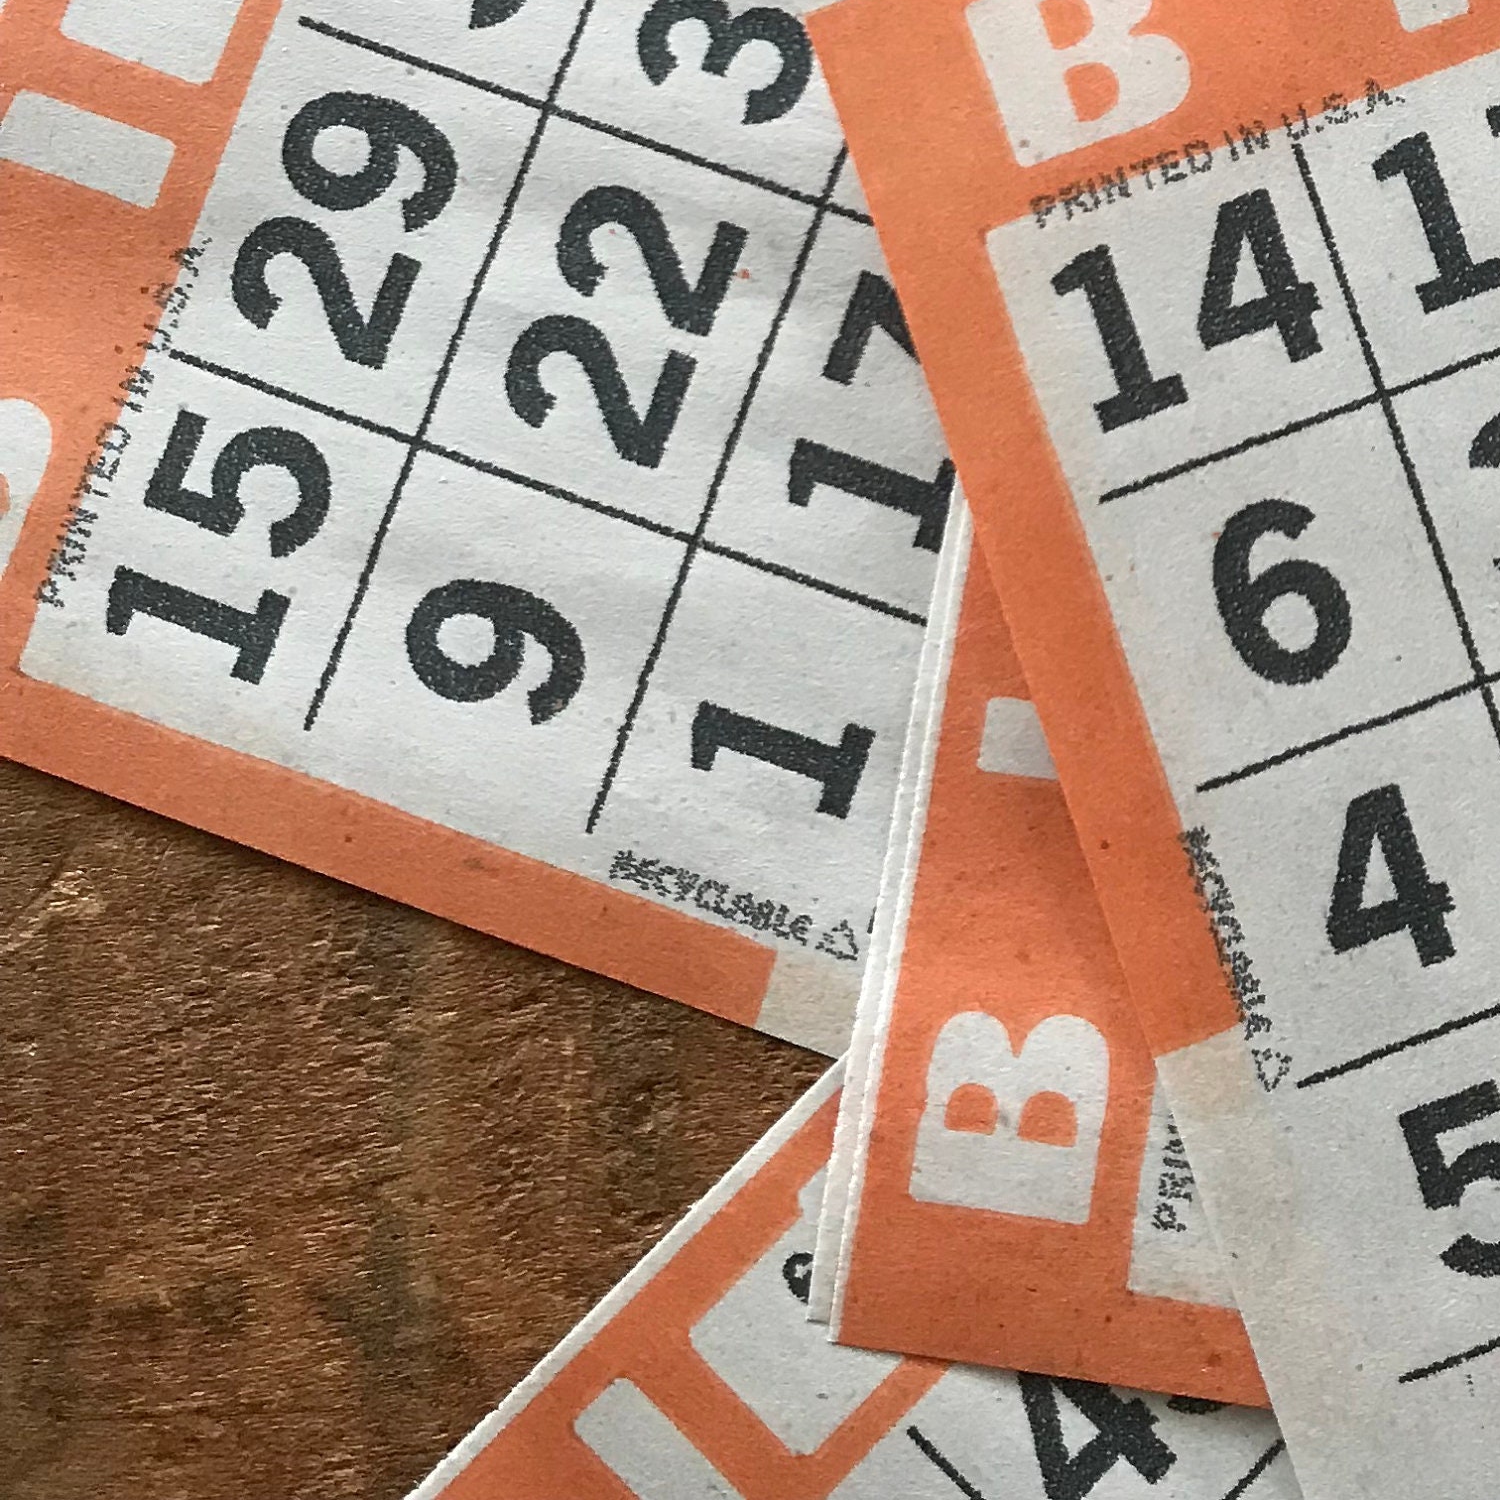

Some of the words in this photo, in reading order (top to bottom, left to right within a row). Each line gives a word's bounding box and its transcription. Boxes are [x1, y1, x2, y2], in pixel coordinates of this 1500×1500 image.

[1029, 139, 1213, 228] PRINTED
[1223, 119, 1270, 161] IN
[1281, 78, 1405, 141] U.S.A.
[106, 410, 331, 685] 15
[231, 90, 458, 369] 29
[1050, 189, 1322, 433] 14
[36, 420, 131, 608] PRINTED
[114, 365, 154, 413] IN
[405, 578, 586, 725] 9
[505, 185, 748, 468] 22
[1212, 499, 1352, 685] 6
[690, 700, 876, 820] 1
[609, 850, 810, 947] RECYCLABLE
[1326, 783, 1456, 968] 4
[909, 1010, 1110, 1225] B
